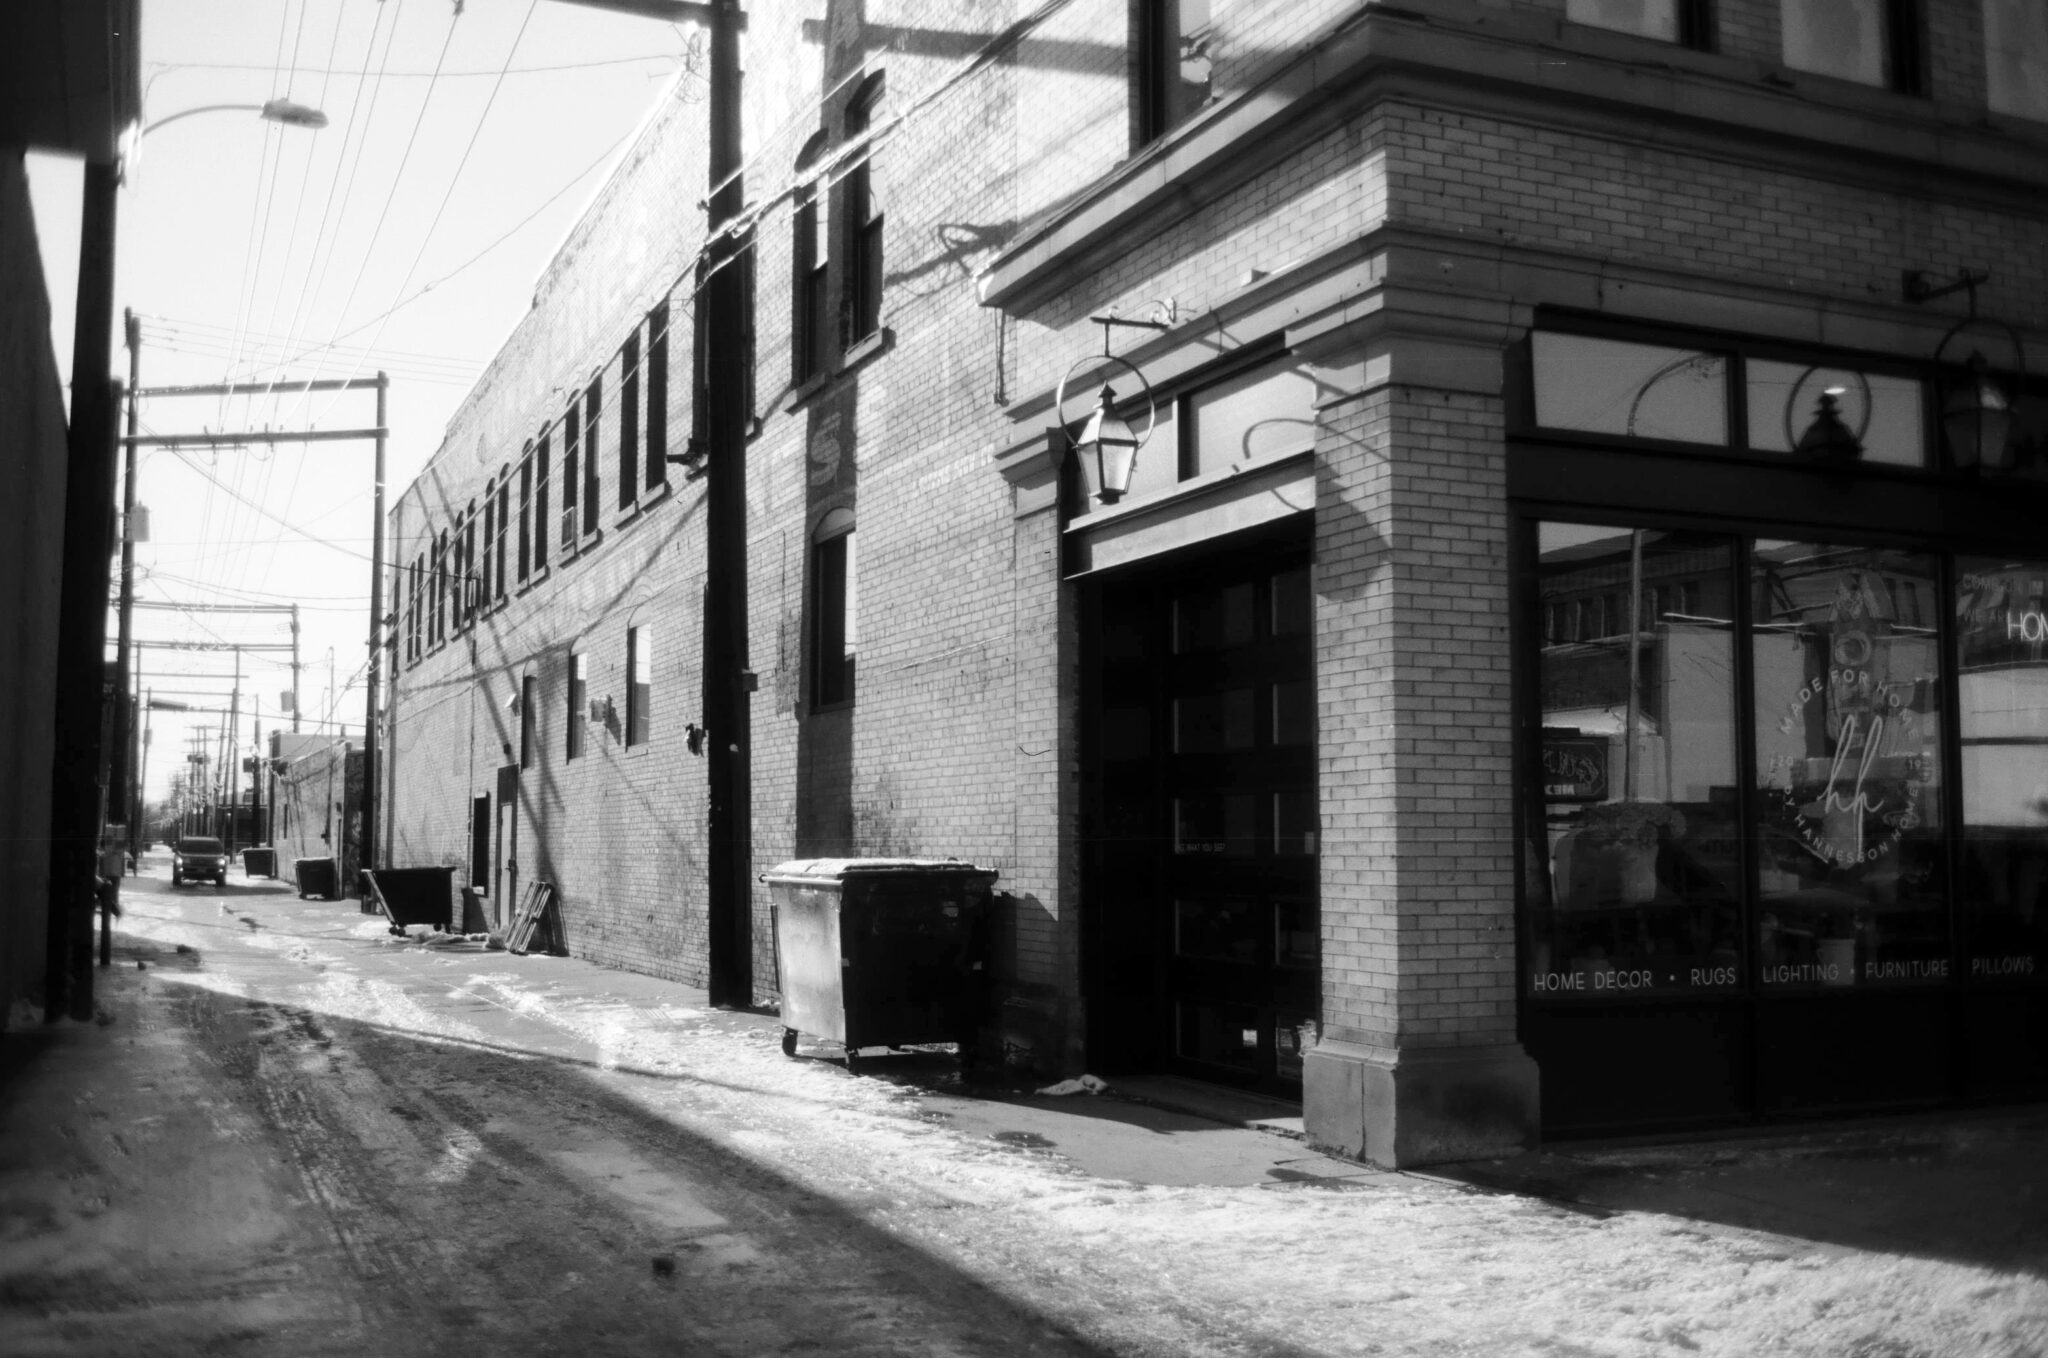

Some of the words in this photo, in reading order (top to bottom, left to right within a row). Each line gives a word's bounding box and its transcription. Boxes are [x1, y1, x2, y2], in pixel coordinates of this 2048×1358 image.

[1778, 676, 1824, 735] MADE
[1831, 668, 1870, 686] FOR
[1876, 680, 1920, 738] HOME
[1784, 784, 1796, 807] BY
[1794, 813, 1889, 864] HANNESSON
[1891, 787, 1920, 844] HOME
[1533, 971, 1585, 991] HOME
[1594, 969, 1654, 990] DECOR
[1690, 967, 1737, 986] RUGS
[1761, 963, 1840, 983] LIGHTING
[1865, 959, 1949, 980] FURNITURE
[1970, 955, 2036, 976] PILLOWS
